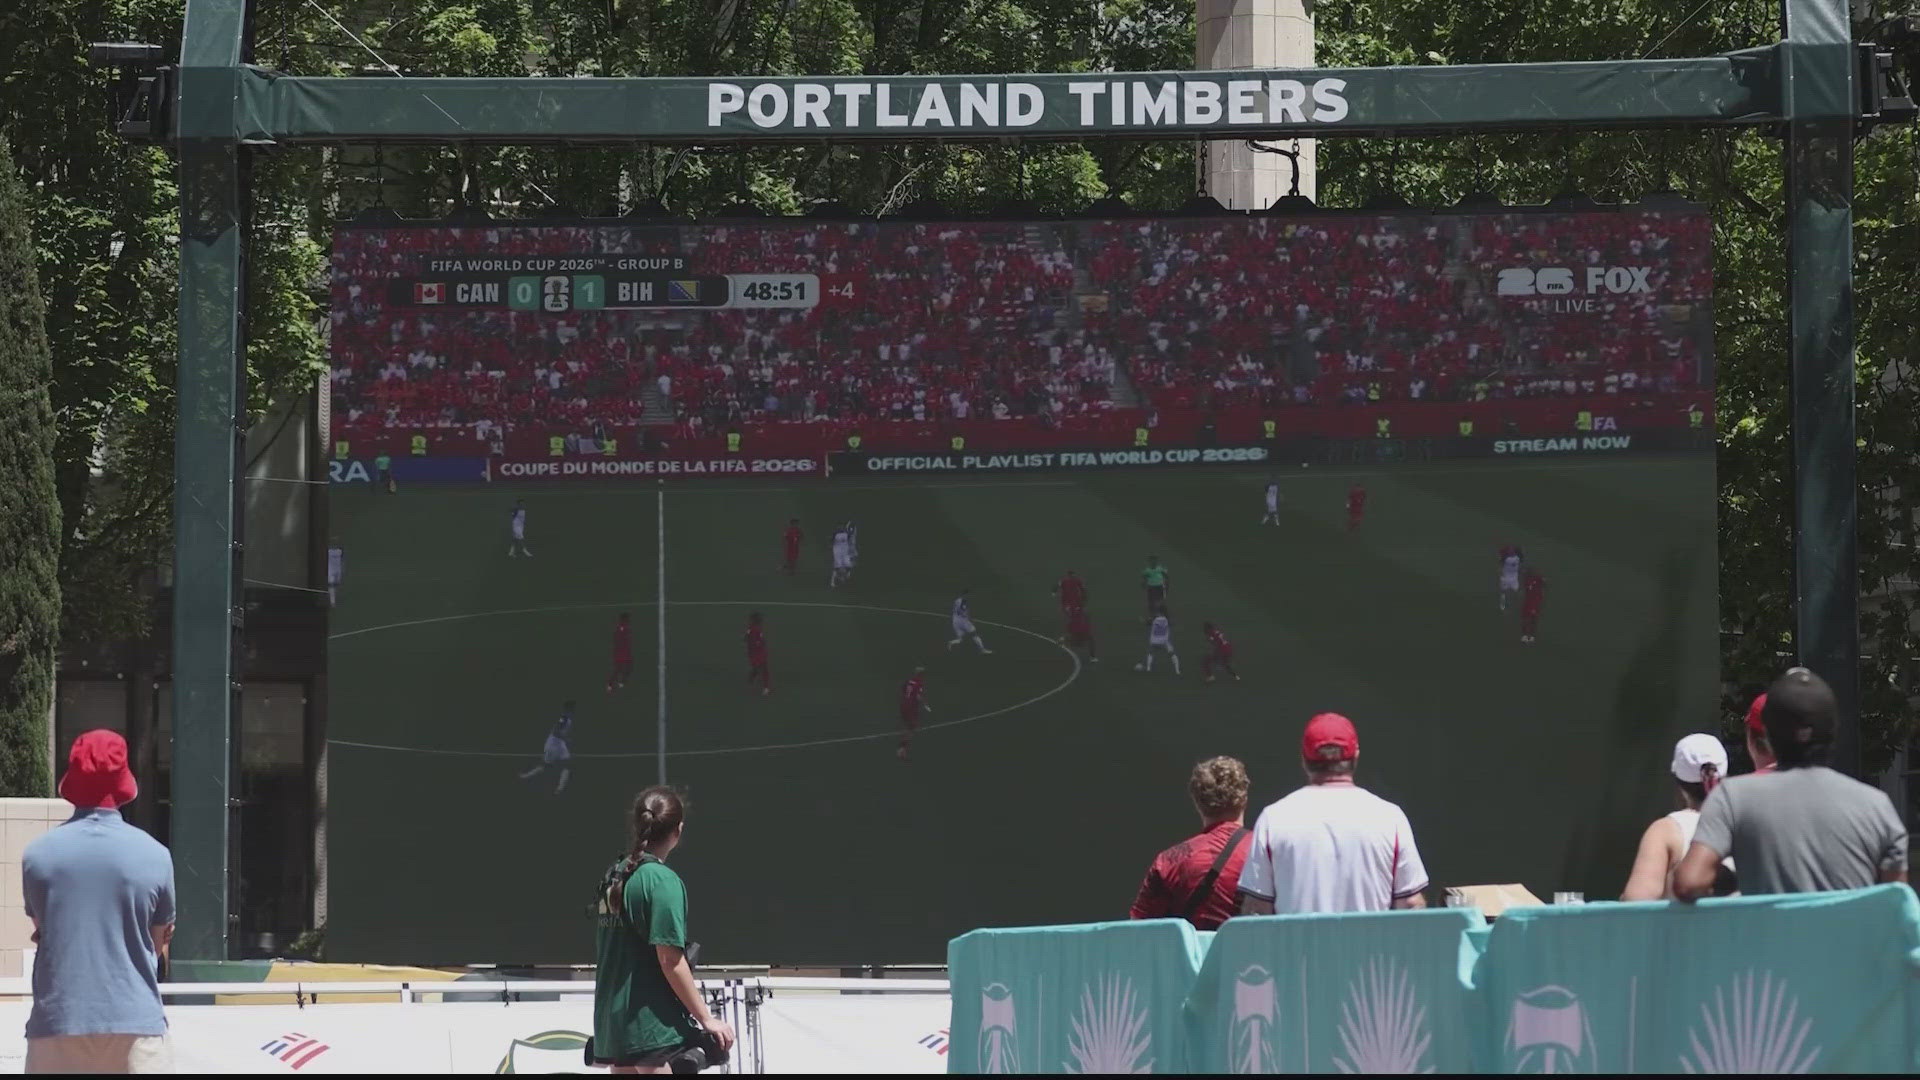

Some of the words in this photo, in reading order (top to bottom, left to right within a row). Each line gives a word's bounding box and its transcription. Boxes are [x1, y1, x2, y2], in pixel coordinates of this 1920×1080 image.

[708, 82, 1044, 127] PORTLAND
[1068, 79, 1349, 126] TIMBERS
[431, 260, 463, 272] FIFA
[467, 259, 522, 271] WORLD
[526, 259, 556, 271] CUP
[617, 258, 669, 270] GROUP
[674, 258, 684, 270] B
[1587, 266, 1652, 294] FOX
[456, 282, 499, 303] CAN
[516, 282, 532, 303] 0
[582, 281, 594, 303] 1
[618, 281, 653, 302] BIH
[743, 281, 805, 301] 48:51
[828, 281, 855, 300] +4
[1555, 299, 1595, 313] LIVE
[1493, 438, 1577, 454] STREAM
[1583, 435, 1631, 450] NOW
[500, 463, 560, 476] COUPE
[563, 462, 587, 475] DU
[591, 461, 655, 474] MONDE
[658, 461, 680, 473] DE
[684, 460, 706, 473] LA
[710, 460, 747, 472] FIFA
[867, 456, 957, 471] OFFICIAL
[963, 454, 1055, 469] PLAYLIST
[1060, 453, 1097, 466] FIFA
[1099, 450, 1162, 465] WORLD
[1165, 449, 1200, 462] CUP
